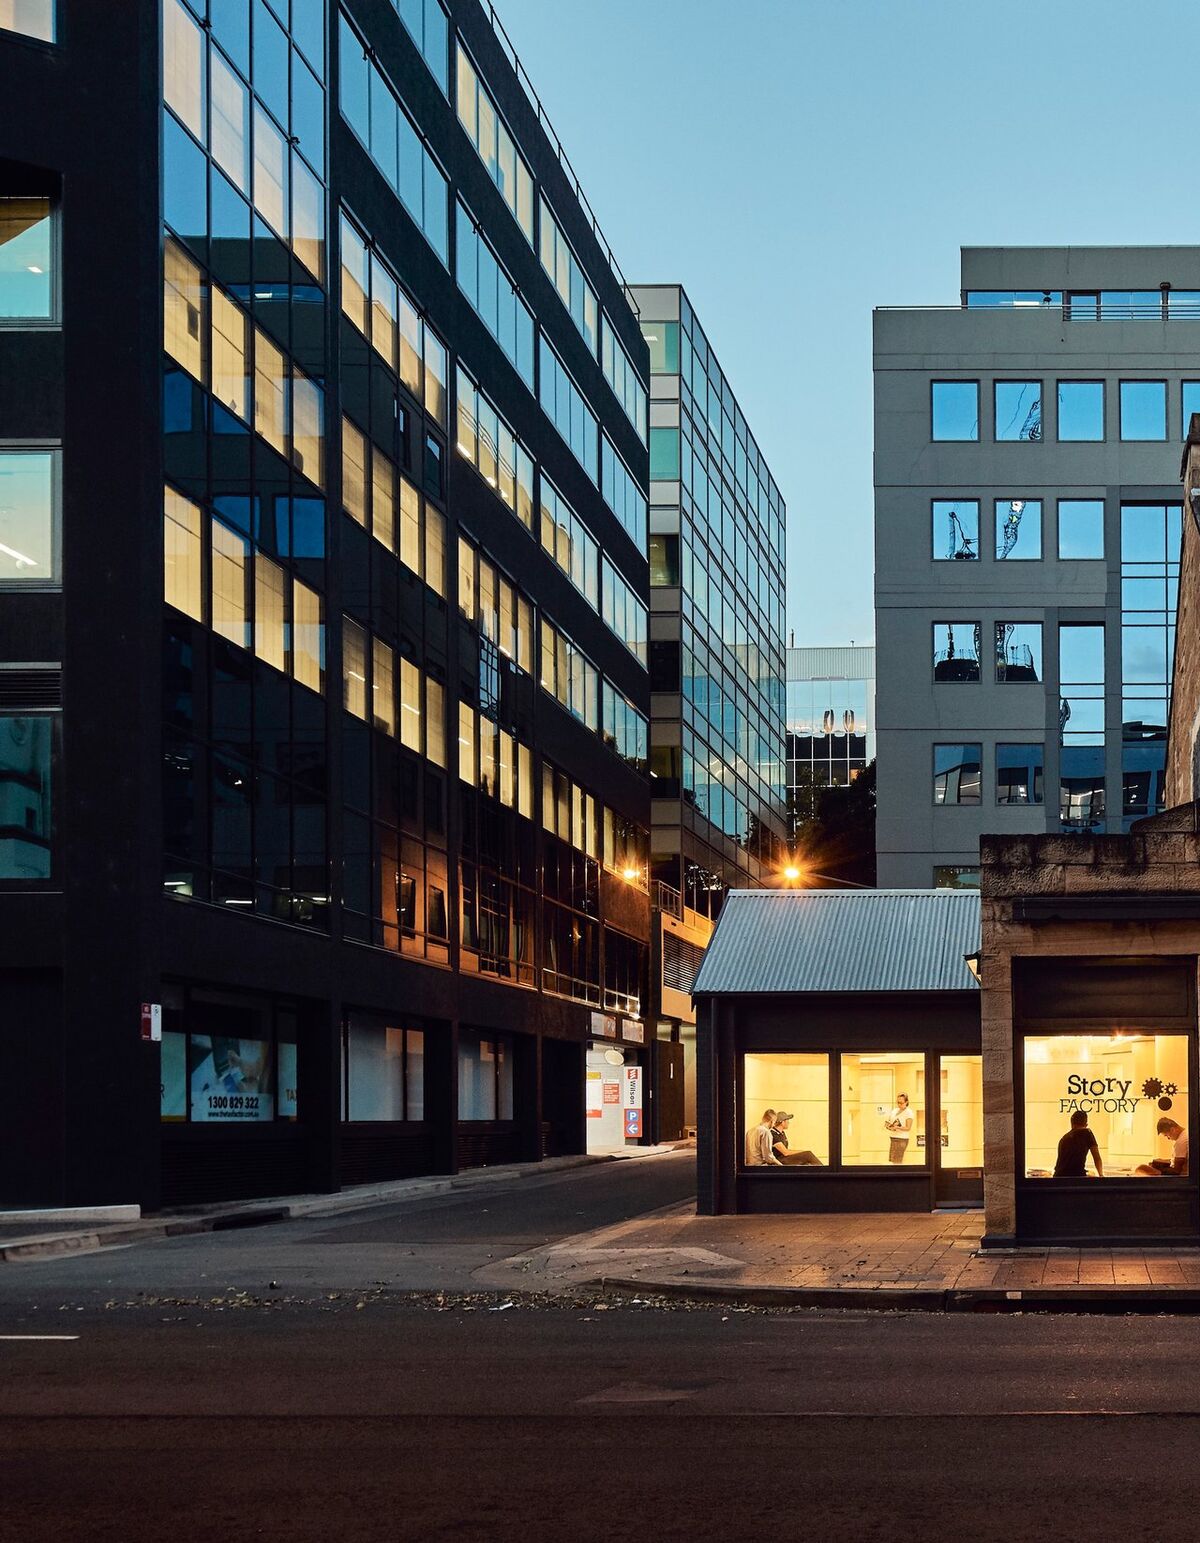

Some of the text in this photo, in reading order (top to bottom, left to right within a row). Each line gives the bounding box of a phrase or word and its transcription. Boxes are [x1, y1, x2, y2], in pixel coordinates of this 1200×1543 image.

[1067, 1074, 1132, 1099] Story
[208, 1096, 259, 1109] 1300 829 322
[1059, 1098, 1141, 1113] FACTORY
[630, 1112, 637, 1120] P
